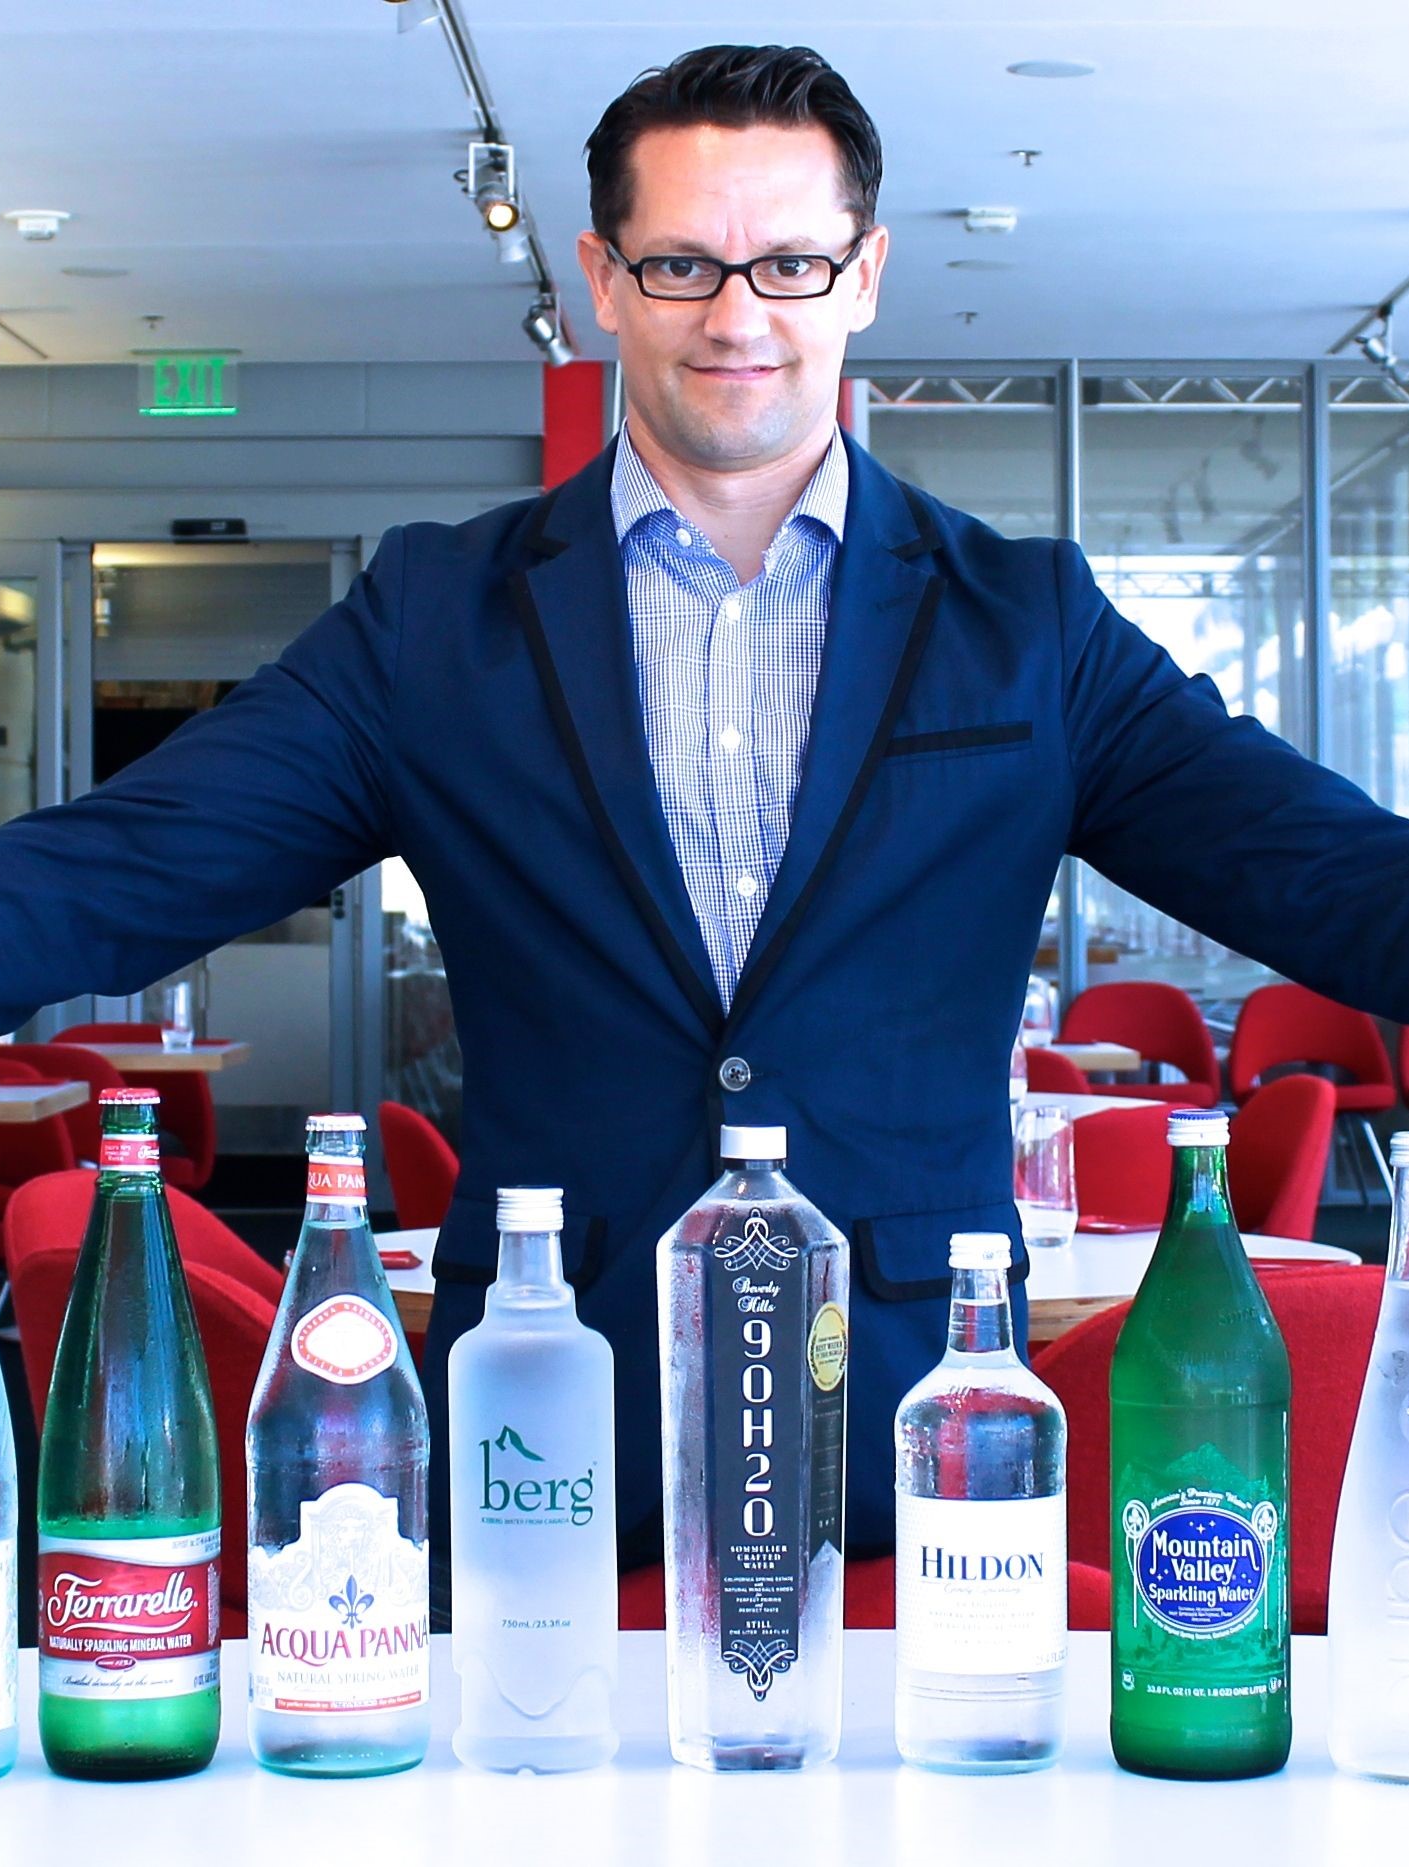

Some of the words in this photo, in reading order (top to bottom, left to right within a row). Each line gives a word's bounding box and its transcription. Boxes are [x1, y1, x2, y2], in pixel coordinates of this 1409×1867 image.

[155, 357, 227, 406] EXIT
[733, 1277, 780, 1297] Beverly
[738, 1296, 775, 1312] Hills
[479, 1438, 593, 1526] berg
[921, 1545, 1044, 1581] HILDON
[1149, 1530, 1260, 1575] Mountain
[1171, 1558, 1237, 1585] Valley
[47, 1571, 194, 1627] Ferrarelle
[1149, 1583, 1216, 1607] Sparkling
[1217, 1586, 1255, 1603] Water
[49, 1635, 83, 1652] NATURALLY
[83, 1638, 129, 1653] SPARKLING
[130, 1638, 166, 1652] MINERAL
[166, 1633, 192, 1649] WATER
[261, 1622, 352, 1667] ACQUA
[360, 1614, 429, 1658] PANNA
[278, 1671, 333, 1685] NATURAL
[337, 1671, 386, 1684] SPRING
